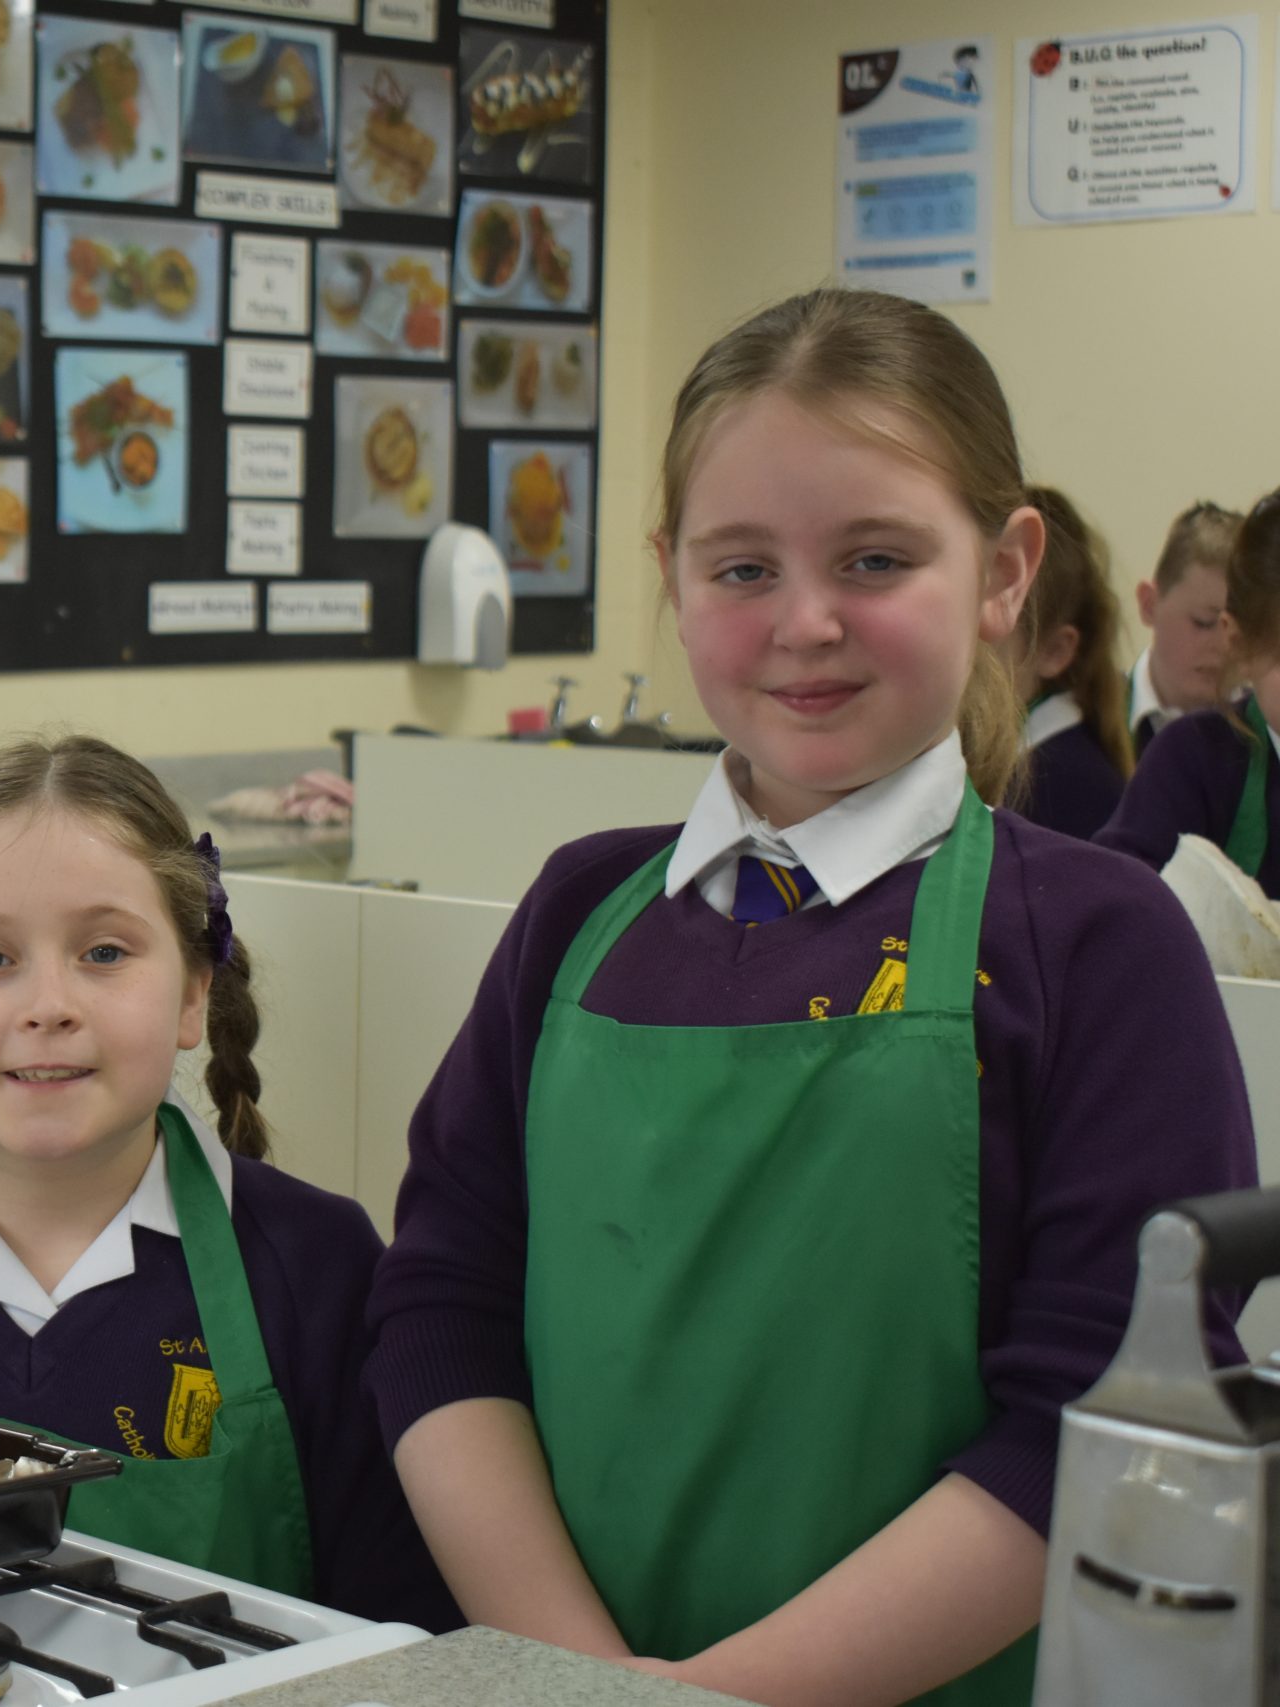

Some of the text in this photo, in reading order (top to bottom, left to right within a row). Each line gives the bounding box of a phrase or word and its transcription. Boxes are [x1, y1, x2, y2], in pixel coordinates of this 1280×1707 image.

[1116, 43, 1137, 60] the
[881, 936, 908, 952] St
[159, 1338, 186, 1356] St
